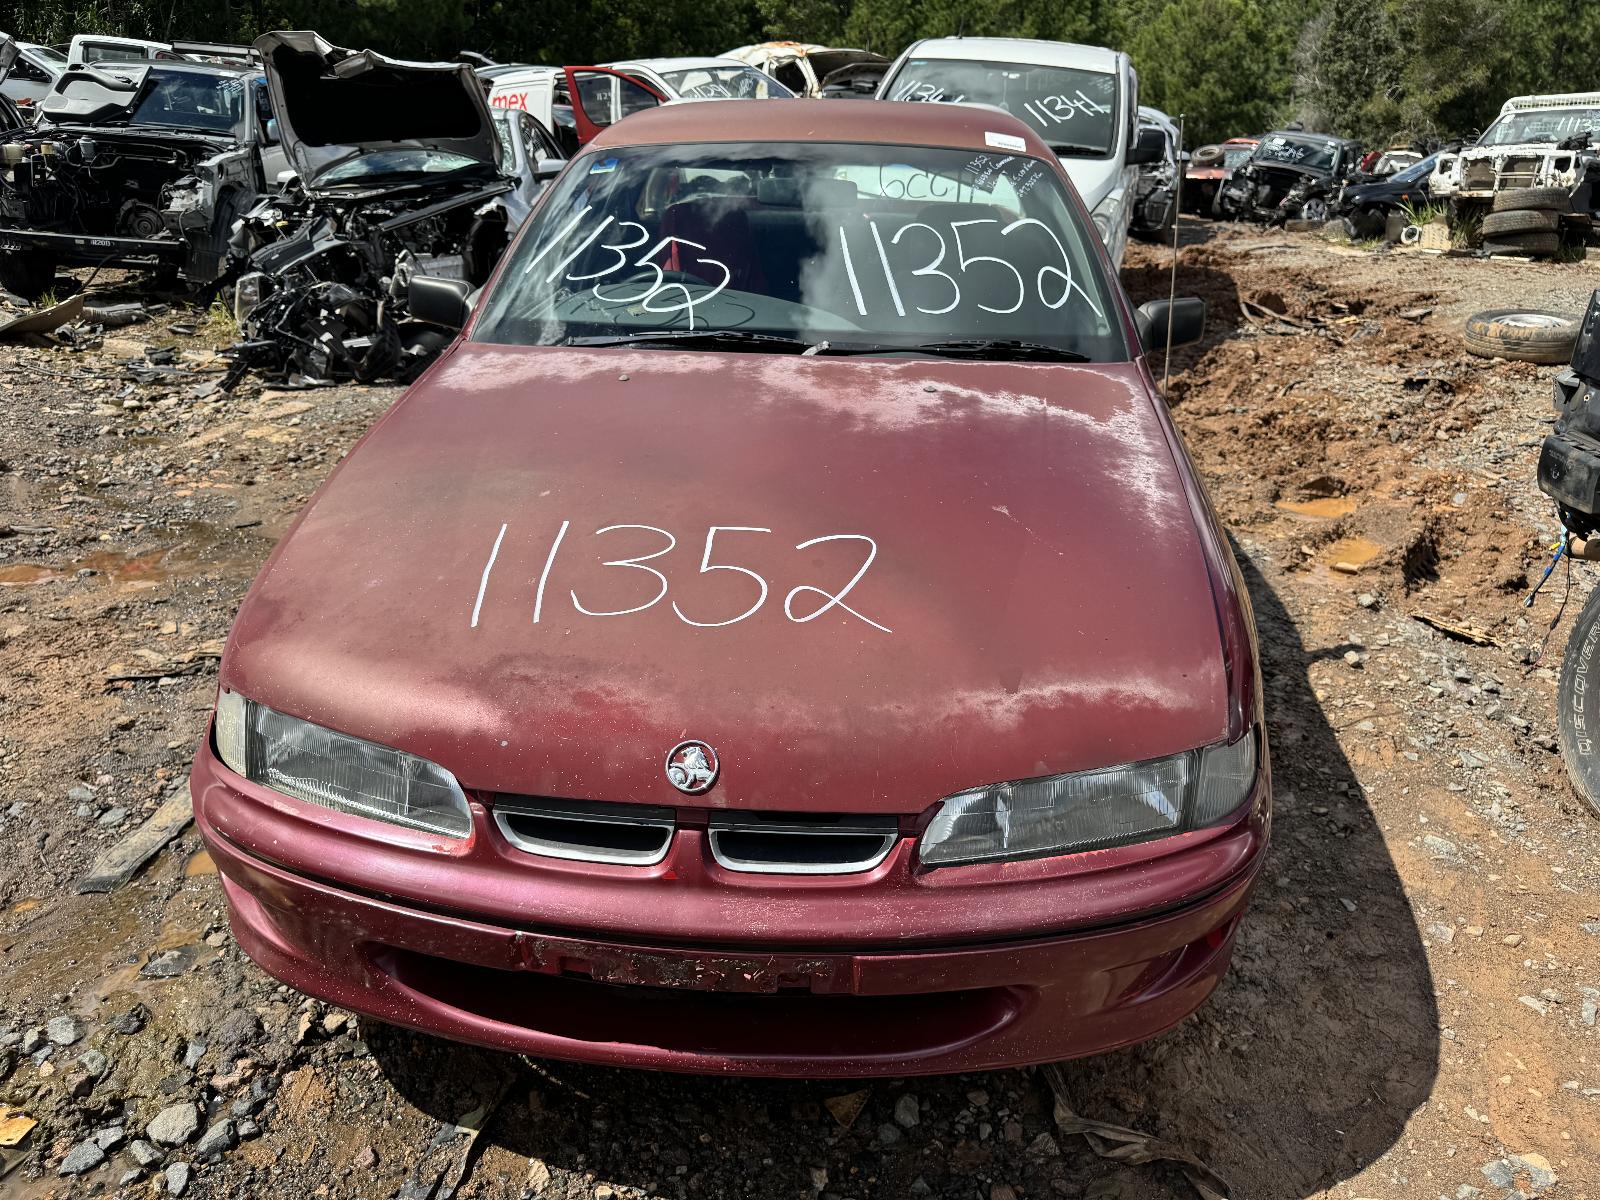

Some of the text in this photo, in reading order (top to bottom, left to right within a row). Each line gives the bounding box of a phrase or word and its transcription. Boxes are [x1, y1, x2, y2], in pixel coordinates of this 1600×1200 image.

[1023, 89, 1105, 127] 11341
[964, 155, 991, 175] 11352
[525, 204, 731, 331] 11352
[838, 217, 1103, 317] 11352
[470, 519, 893, 633] 11352
